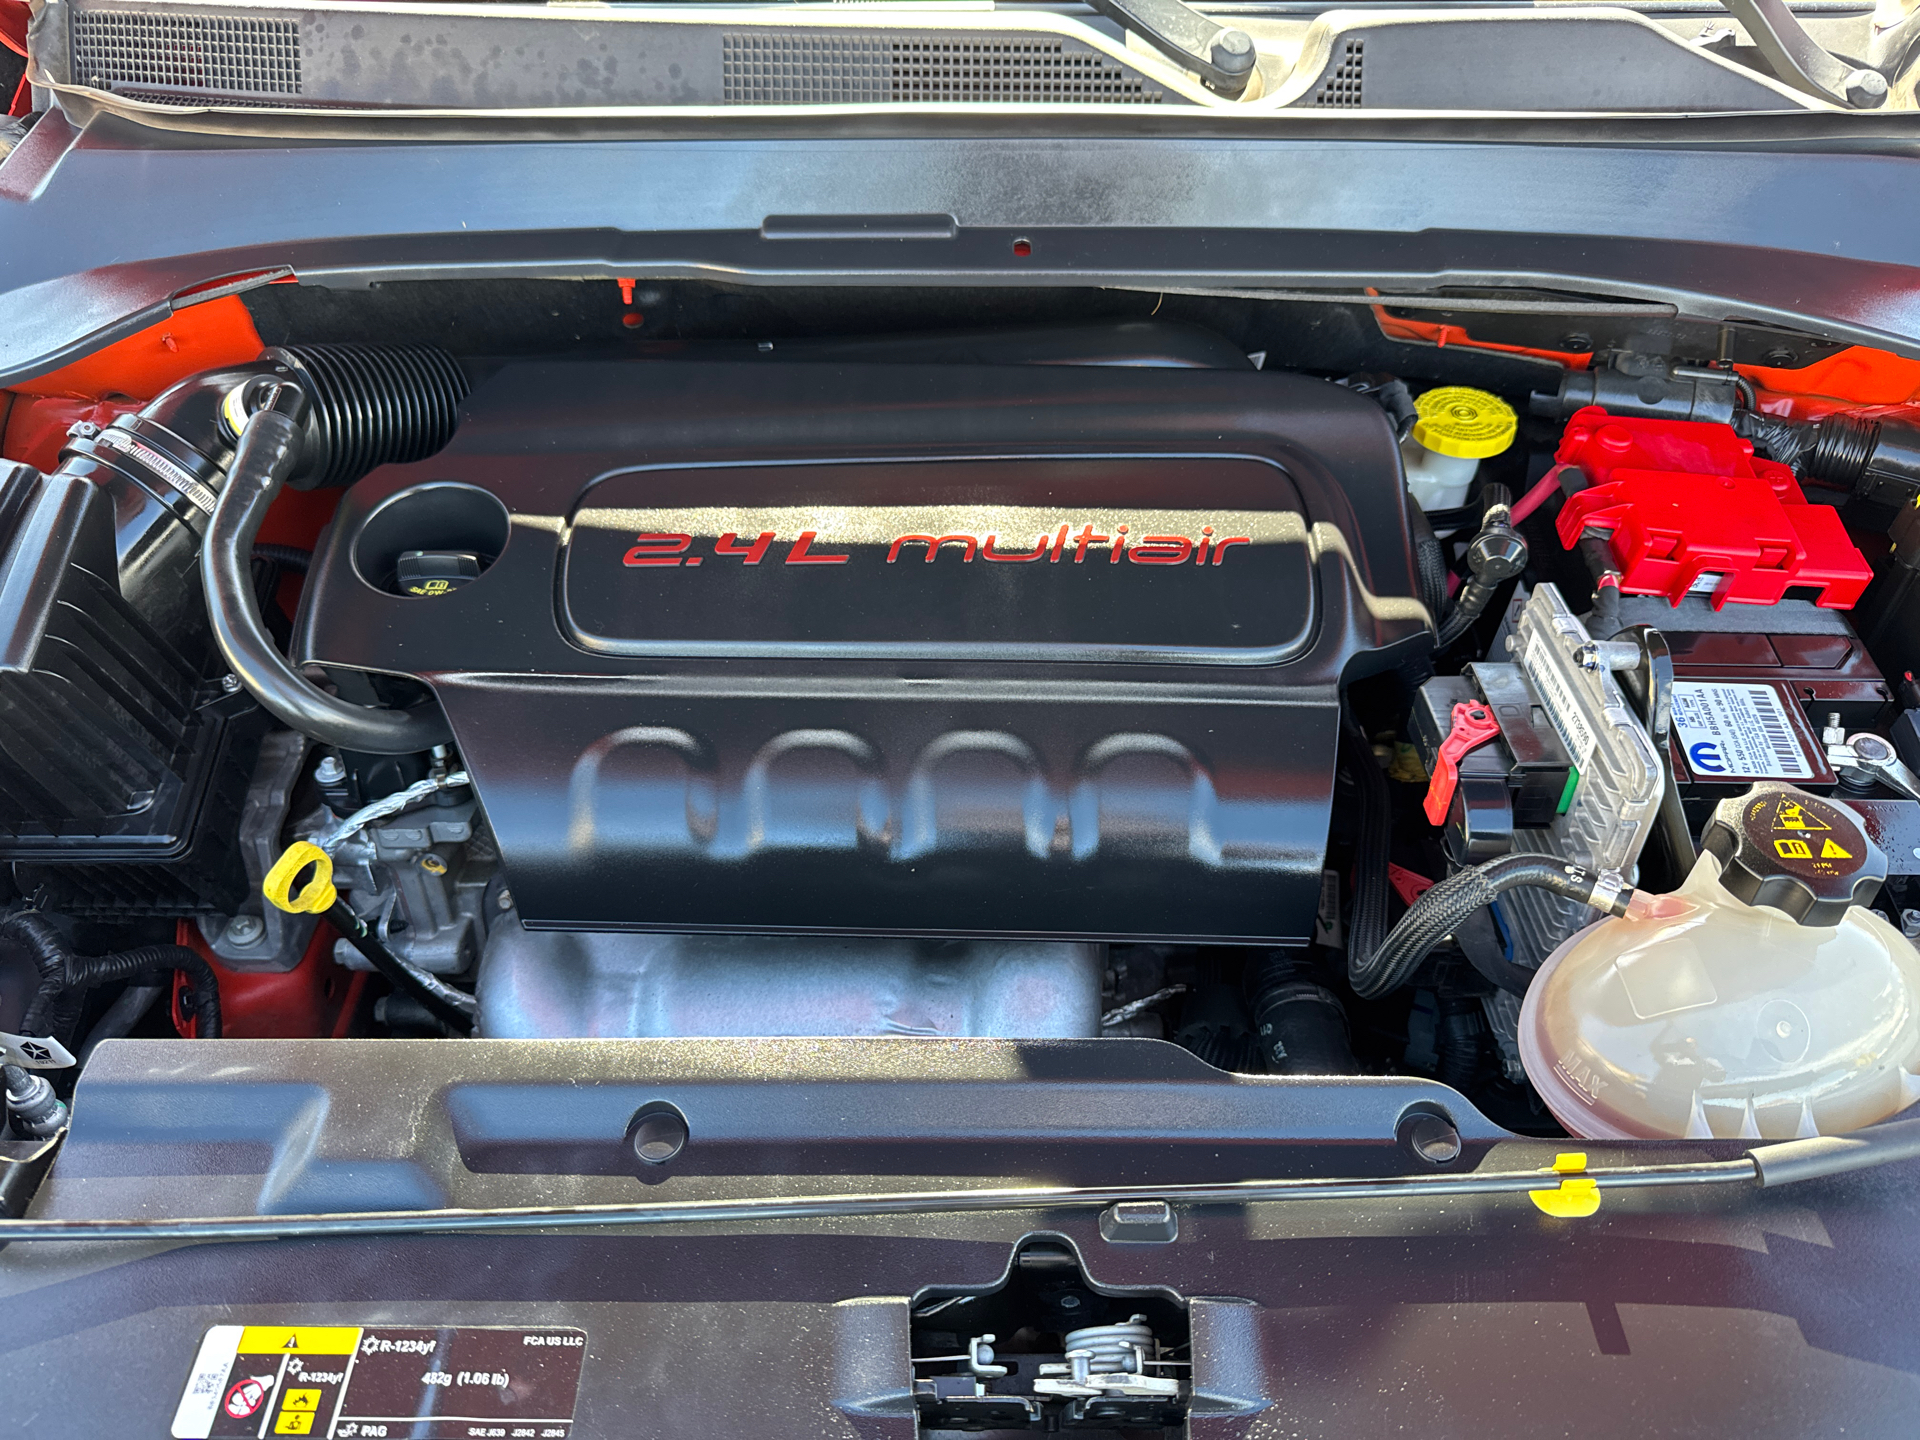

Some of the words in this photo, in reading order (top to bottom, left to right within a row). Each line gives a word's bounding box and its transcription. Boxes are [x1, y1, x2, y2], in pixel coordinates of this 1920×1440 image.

[622, 531, 850, 568] 2.4L
[885, 523, 1251, 567] multiair
[1695, 689, 1721, 735] BBH5A001AA
[1676, 717, 1687, 727] 36
[1720, 743, 1736, 773] MOPAR
[1735, 749, 1746, 760] 550
[1557, 1050, 1609, 1099] MAX
[380, 1340, 437, 1356] R-1234yf
[523, 1336, 546, 1346] FCA
[546, 1336, 562, 1346] US
[562, 1336, 584, 1346] LLC
[298, 1371, 344, 1385] R-1234yf
[421, 1371, 453, 1387] 482g
[456, 1371, 490, 1387] (1.06
[361, 1425, 388, 1437] PAG
[467, 1427, 487, 1437] SAE
[486, 1428, 506, 1438] J639
[510, 1428, 536, 1438] J2842
[540, 1428, 566, 1438] J2845
